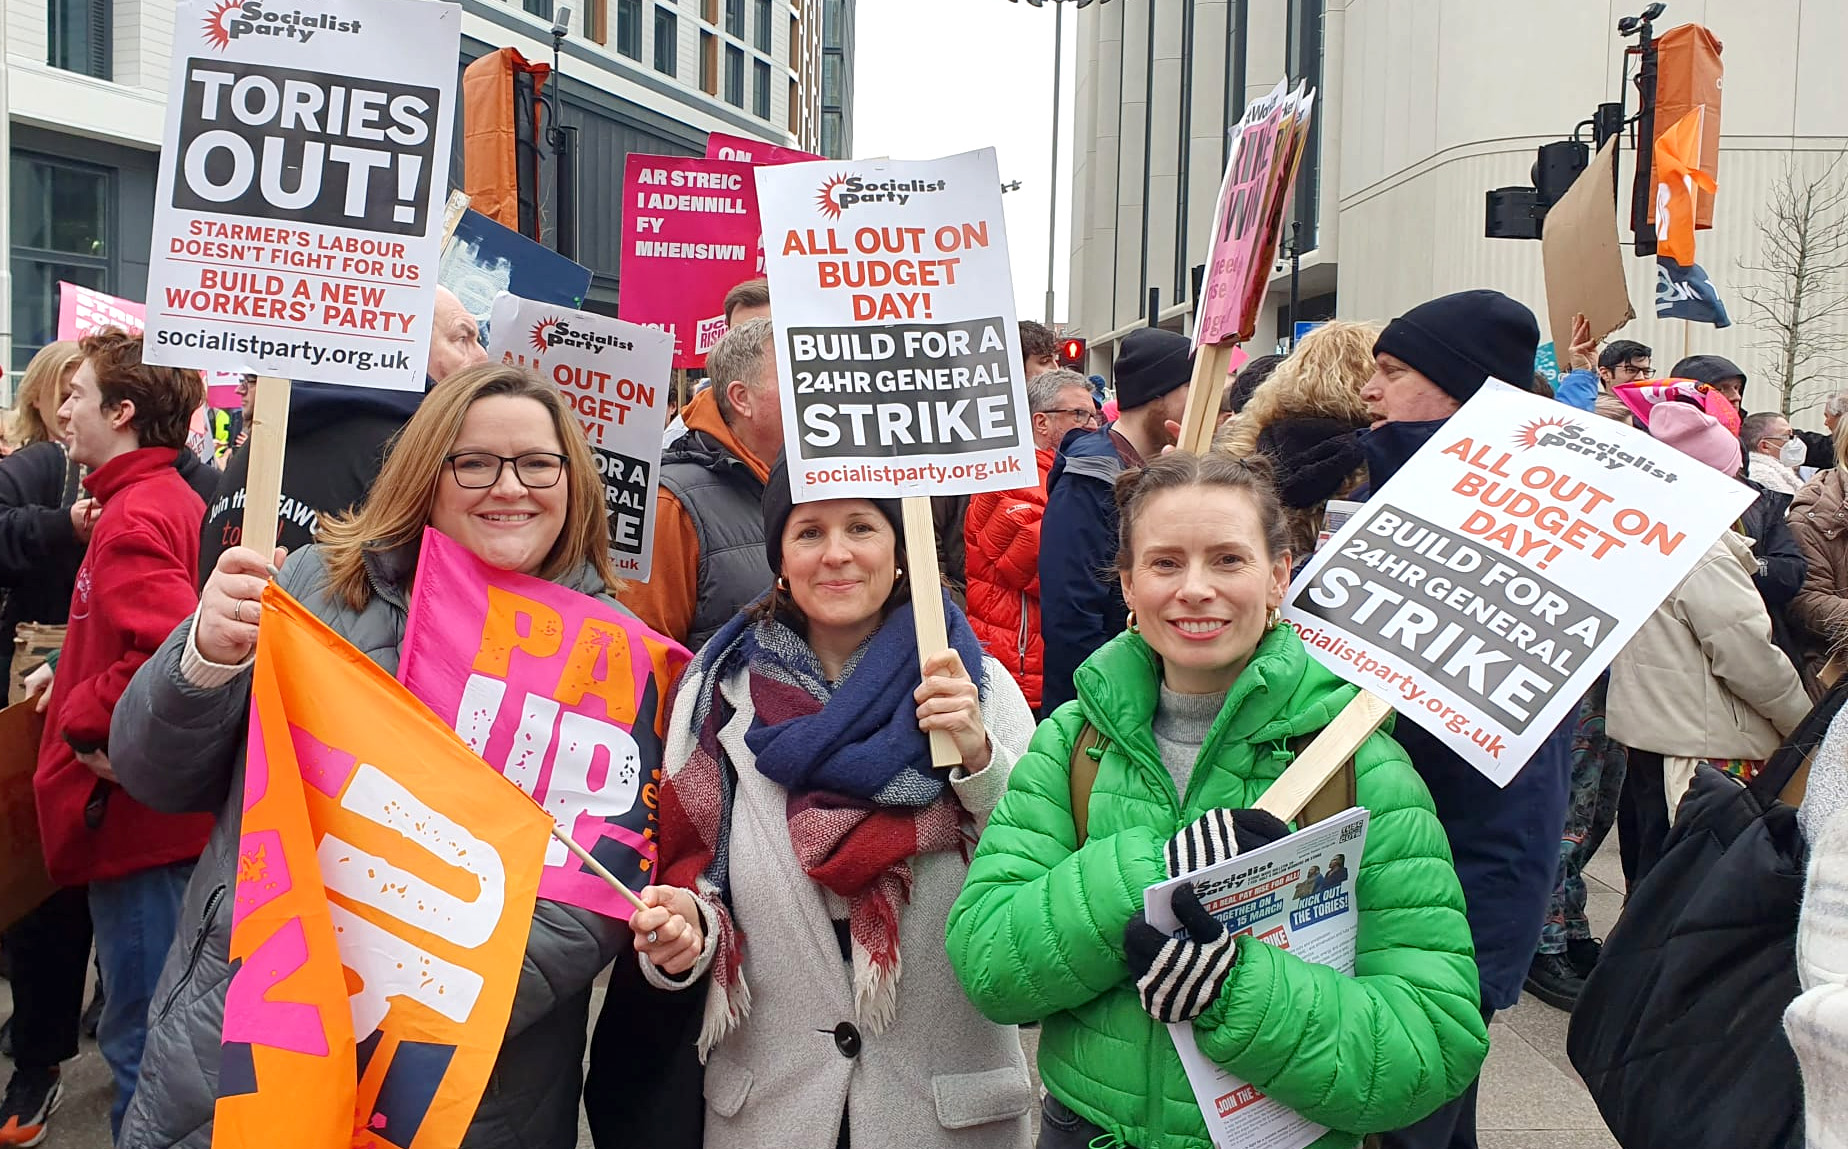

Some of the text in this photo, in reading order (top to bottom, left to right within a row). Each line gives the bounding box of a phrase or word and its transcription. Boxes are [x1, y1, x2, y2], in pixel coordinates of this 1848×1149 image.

[229, 20, 315, 43] Party
[240, 1, 362, 33] Socialist
[192, 69, 430, 146] TORIES
[718, 147, 752, 163] ON
[184, 129, 423, 224] OUT!
[637, 168, 742, 190] AR STREIC
[845, 176, 946, 194] Socialist
[637, 192, 747, 215] I ADENNILL
[839, 192, 909, 209] Party
[189, 219, 405, 259] STARMER'S LABOUR
[636, 217, 665, 233] FY
[782, 228, 848, 256] ALL
[854, 226, 925, 254] OUT
[934, 220, 990, 250] ON
[170, 237, 420, 281] DOESN'T FIGHT FOR US
[635, 240, 746, 261] MHENSIWN
[200, 268, 386, 308] BUILD A NEW
[817, 257, 961, 289] BUDGET
[165, 288, 416, 334] WORKERS' PARTY
[852, 292, 933, 321] DAY!
[554, 321, 634, 352] Socialist
[702, 320, 729, 332] UC
[157, 329, 409, 371] socialistparty.org.uk
[547, 333, 604, 354] Party
[792, 325, 1005, 362] BUILD FOR A
[553, 364, 655, 408] OUT ON
[796, 362, 1009, 395] 24HR GENERAL
[560, 391, 631, 425] DGET
[803, 394, 1014, 448] STRIKE
[1538, 432, 1624, 470] Party
[1561, 424, 1678, 484] Socialist
[593, 454, 646, 487] OR A
[805, 455, 1021, 485] socialistparty.org.uk
[209, 495, 229, 523] Join
[232, 488, 247, 509] th
[1441, 436, 1687, 557] ALL OUT ON
[1451, 471, 1627, 562] BUDGET
[1458, 508, 1563, 571] DAY!
[1366, 510, 1602, 650] BUILD FOR A
[1340, 538, 1572, 677] 24HR GENERAL
[1308, 565, 1554, 724] STRIKE
[1198, 861, 1273, 893] Socialist
[1220, 894, 1236, 906] REAL
[1239, 889, 1253, 901] PAY
[1255, 884, 1270, 896] RISE
[1272, 879, 1284, 891] FOR
[1285, 872, 1300, 886] ALL!
[1236, 915, 1248, 927] 15
[1249, 902, 1283, 922] MARCH
[1259, 897, 1272, 908] ON
[1293, 895, 1348, 925] THE TORIES!
[1298, 893, 1320, 909] KICK
[1218, 1087, 1254, 1113] JOIN THE
